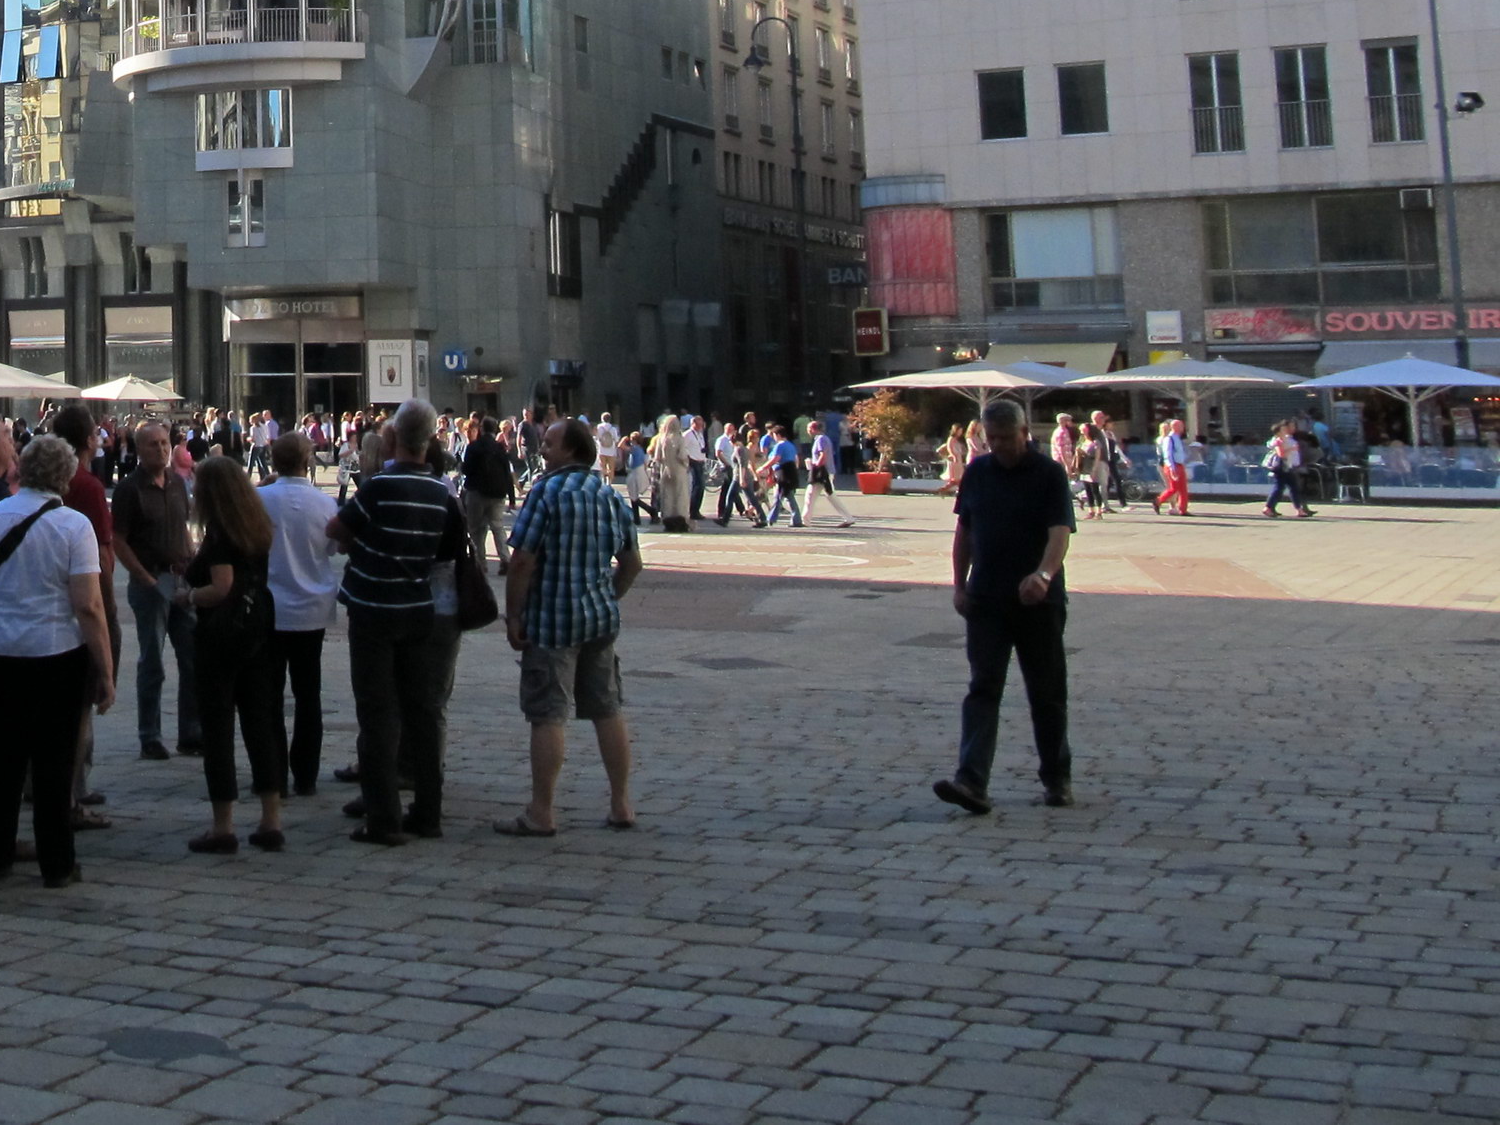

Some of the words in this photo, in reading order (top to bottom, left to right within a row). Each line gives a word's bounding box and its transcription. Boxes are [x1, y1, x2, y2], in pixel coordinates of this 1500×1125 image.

[292, 302, 337, 313] HOTEL
[857, 327, 881, 335] HEINDL
[445, 355, 459, 370] U
